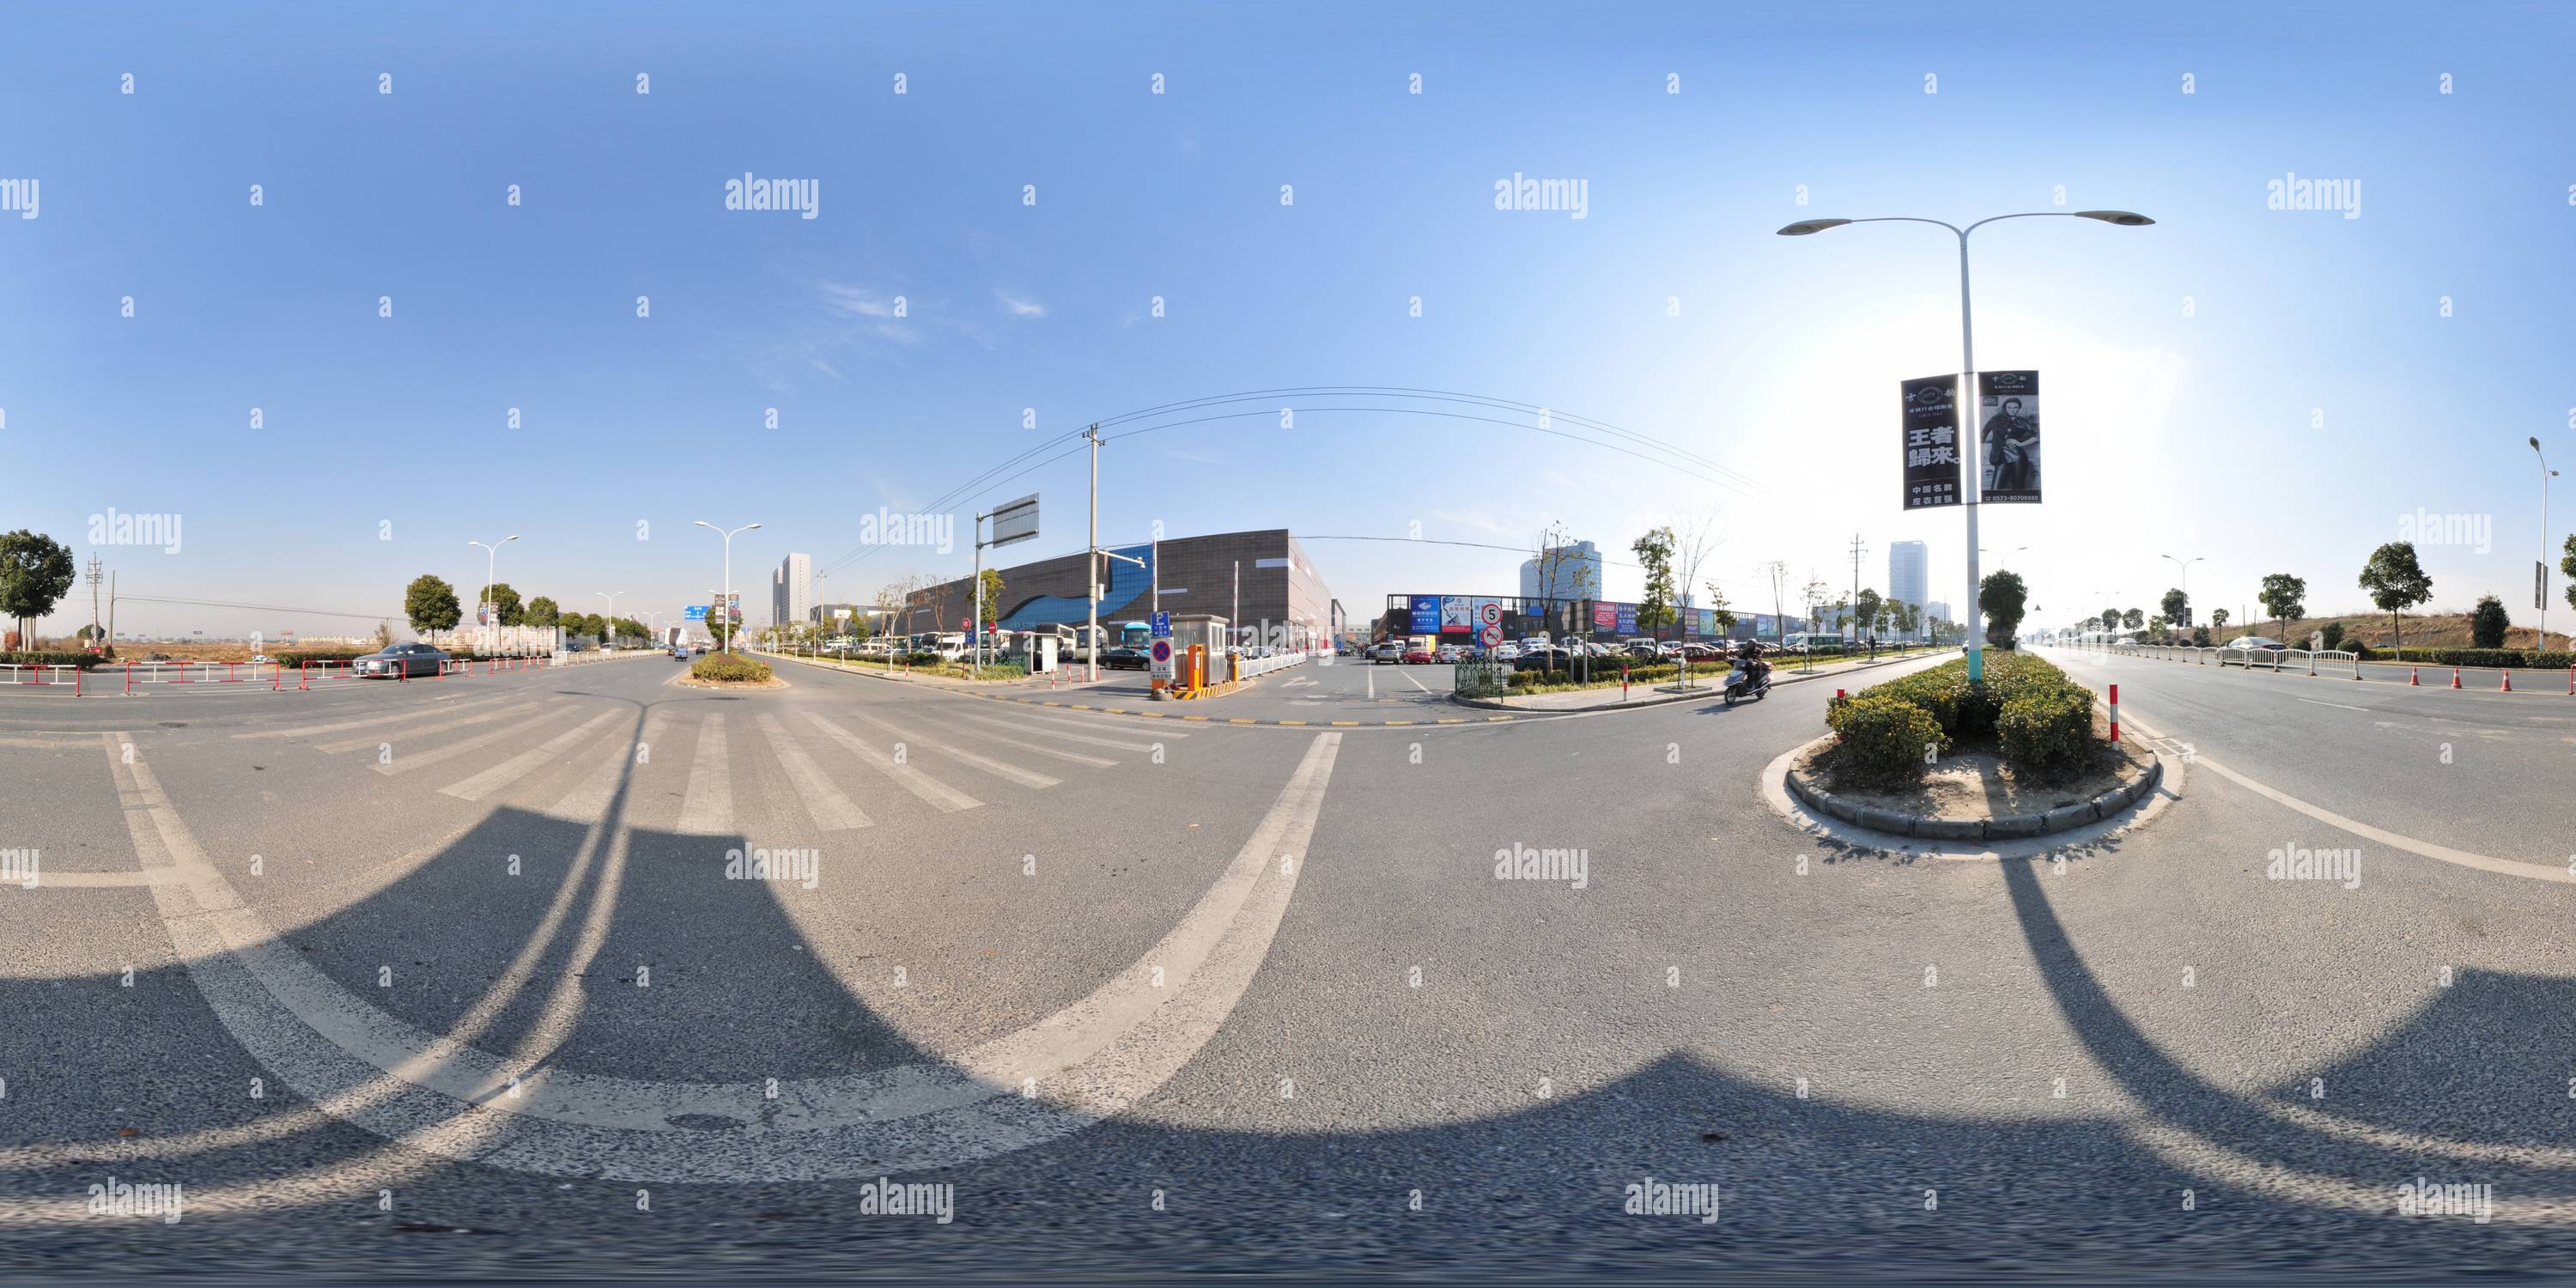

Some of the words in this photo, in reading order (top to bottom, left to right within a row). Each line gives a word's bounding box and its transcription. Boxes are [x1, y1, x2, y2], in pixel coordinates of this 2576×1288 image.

[1908, 426, 1954, 447] 王者
[1157, 613, 1163, 625] P
[1489, 609, 1496, 620] 5
